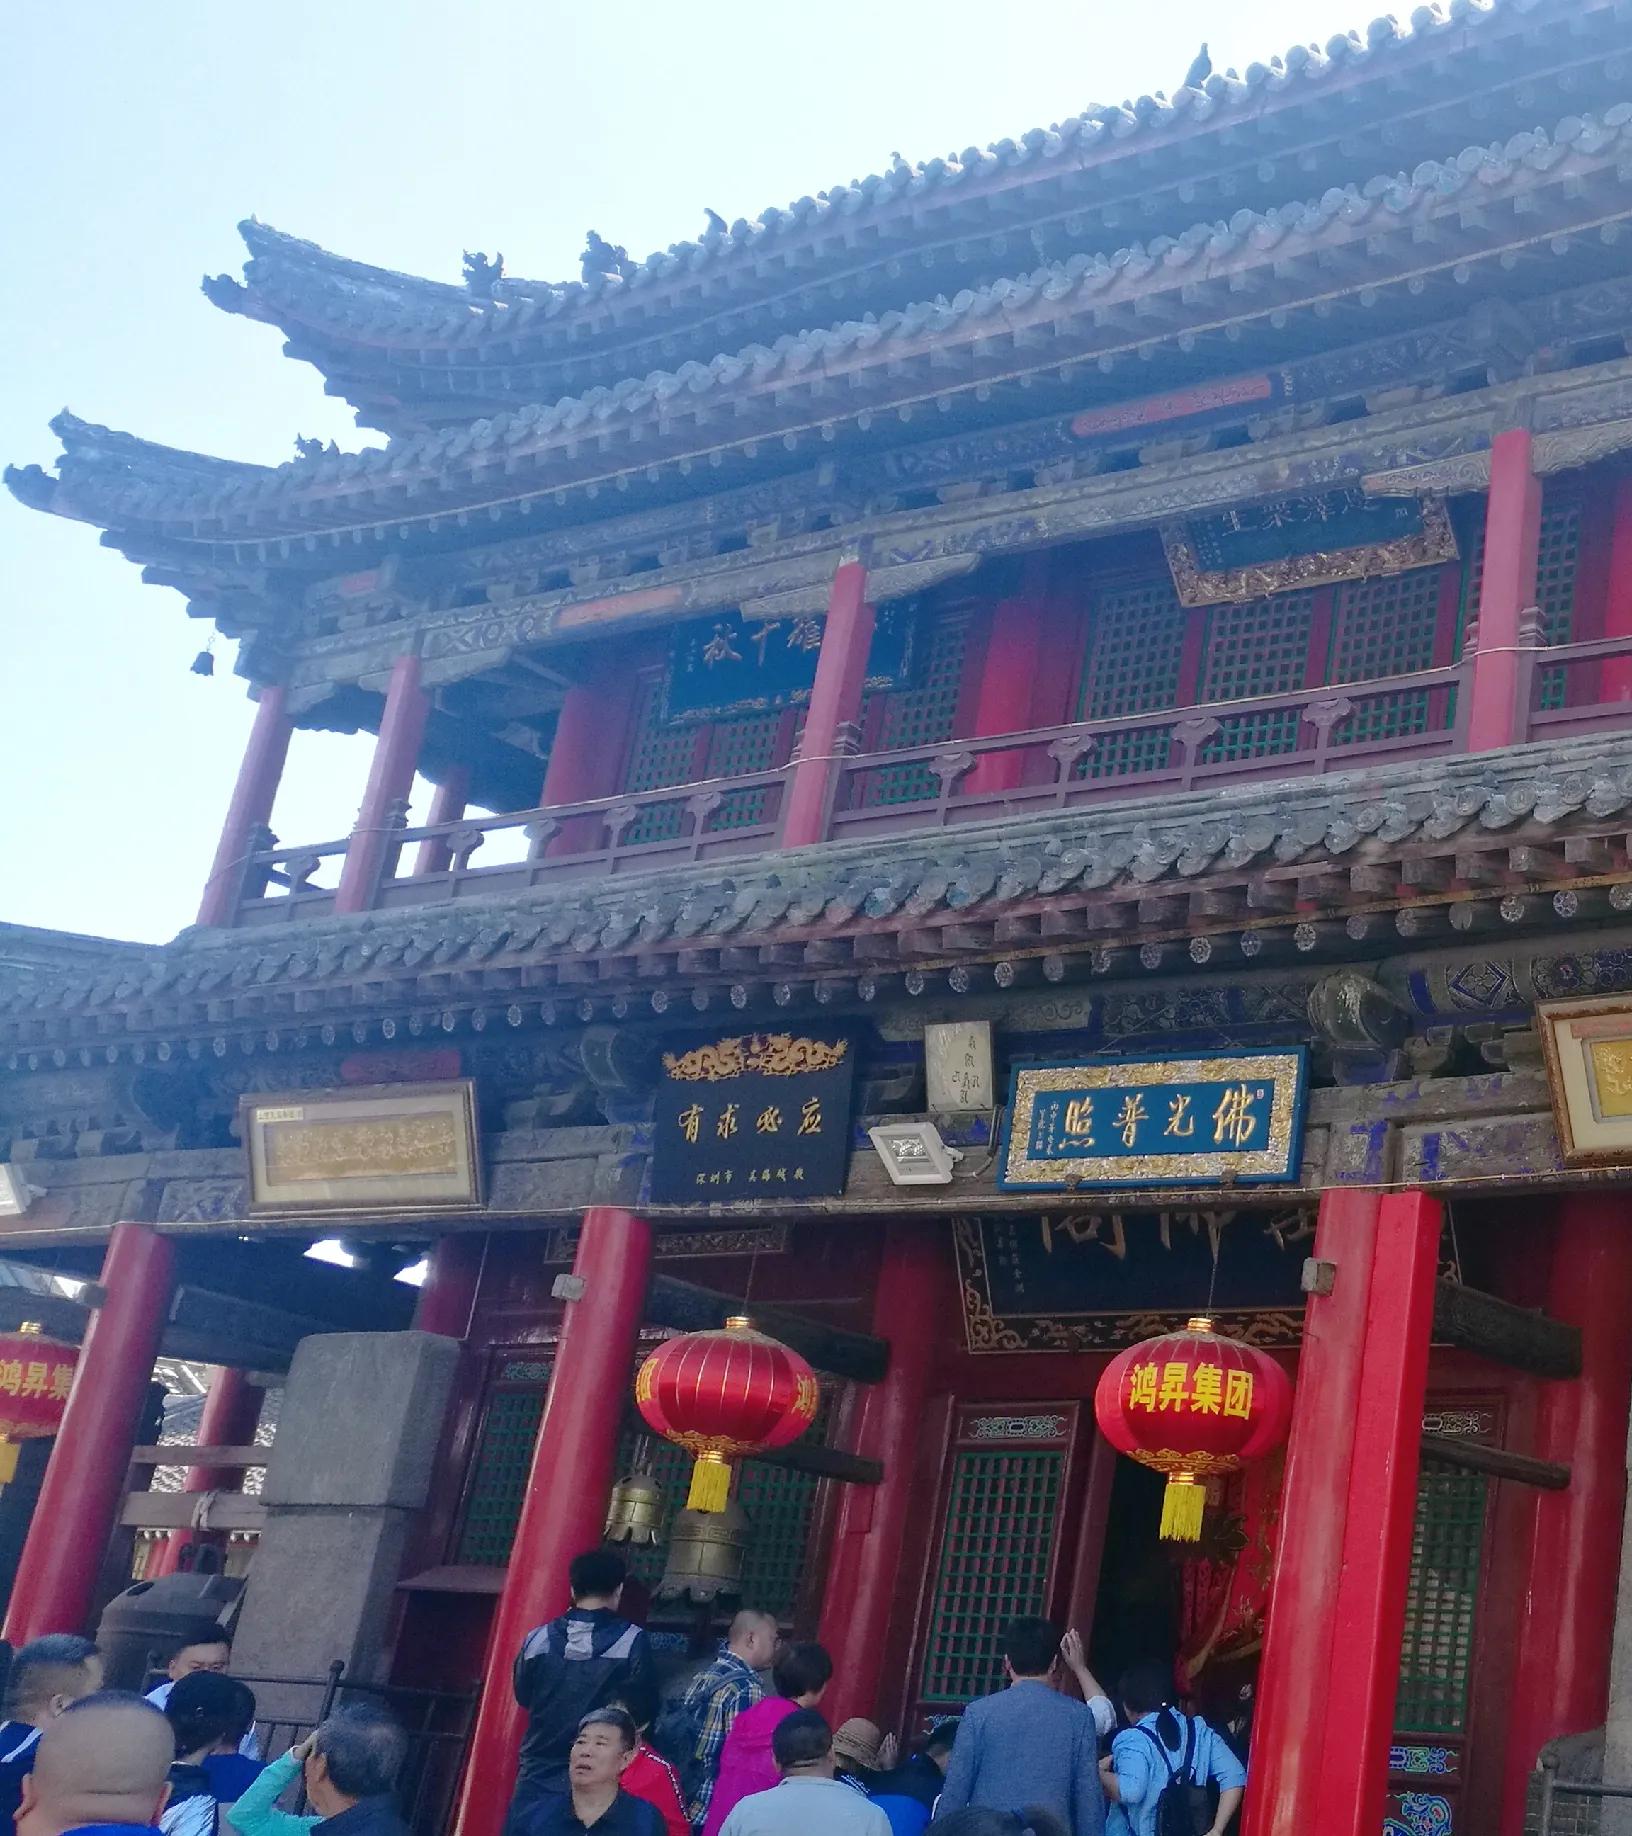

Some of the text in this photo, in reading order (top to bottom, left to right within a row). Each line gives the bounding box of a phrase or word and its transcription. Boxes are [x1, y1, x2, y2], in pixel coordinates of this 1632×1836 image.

[678, 1096, 823, 1144] 有求必应
[1058, 1083, 1256, 1149] 佛光普照
[1129, 1362, 1253, 1420] 鸿昇集团
